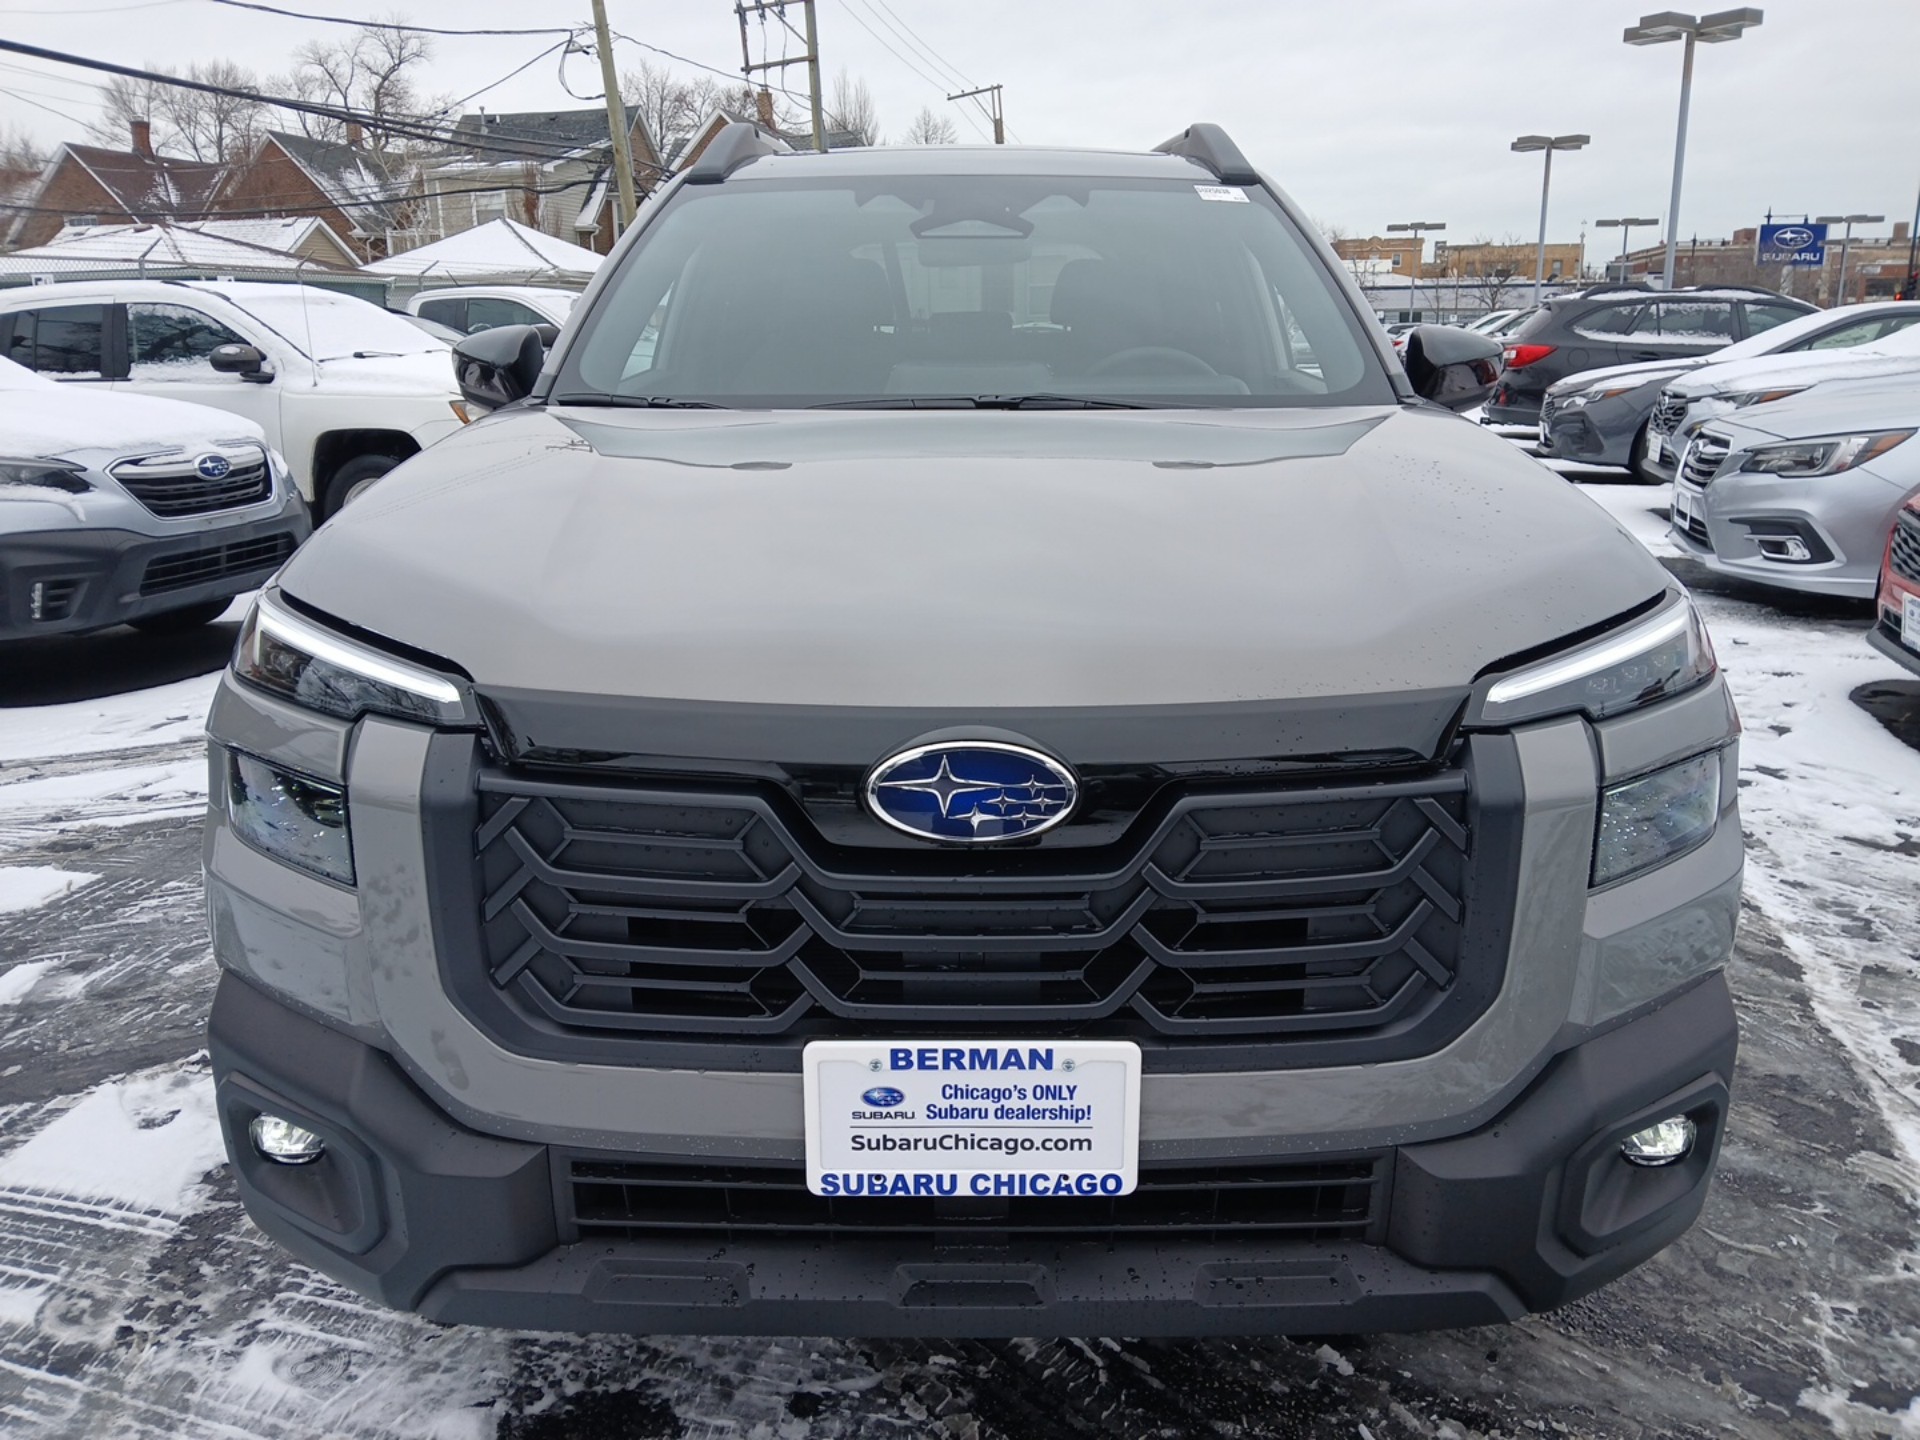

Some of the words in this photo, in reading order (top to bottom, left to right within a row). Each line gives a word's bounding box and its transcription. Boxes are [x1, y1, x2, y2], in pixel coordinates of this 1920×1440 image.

[1762, 252, 1820, 261] SUBARU
[890, 1048, 1054, 1071] BERMAN
[941, 1084, 1027, 1103] Chicago's
[1032, 1084, 1077, 1101] ONLY
[851, 1111, 915, 1120] SUBARU
[926, 1104, 989, 1120] Subaru
[994, 1104, 1092, 1123] dealership!
[851, 1134, 1093, 1155] SubaruChicago.com
[820, 1173, 958, 1196] SUBARU
[969, 1172, 1124, 1196] CHICAGO
